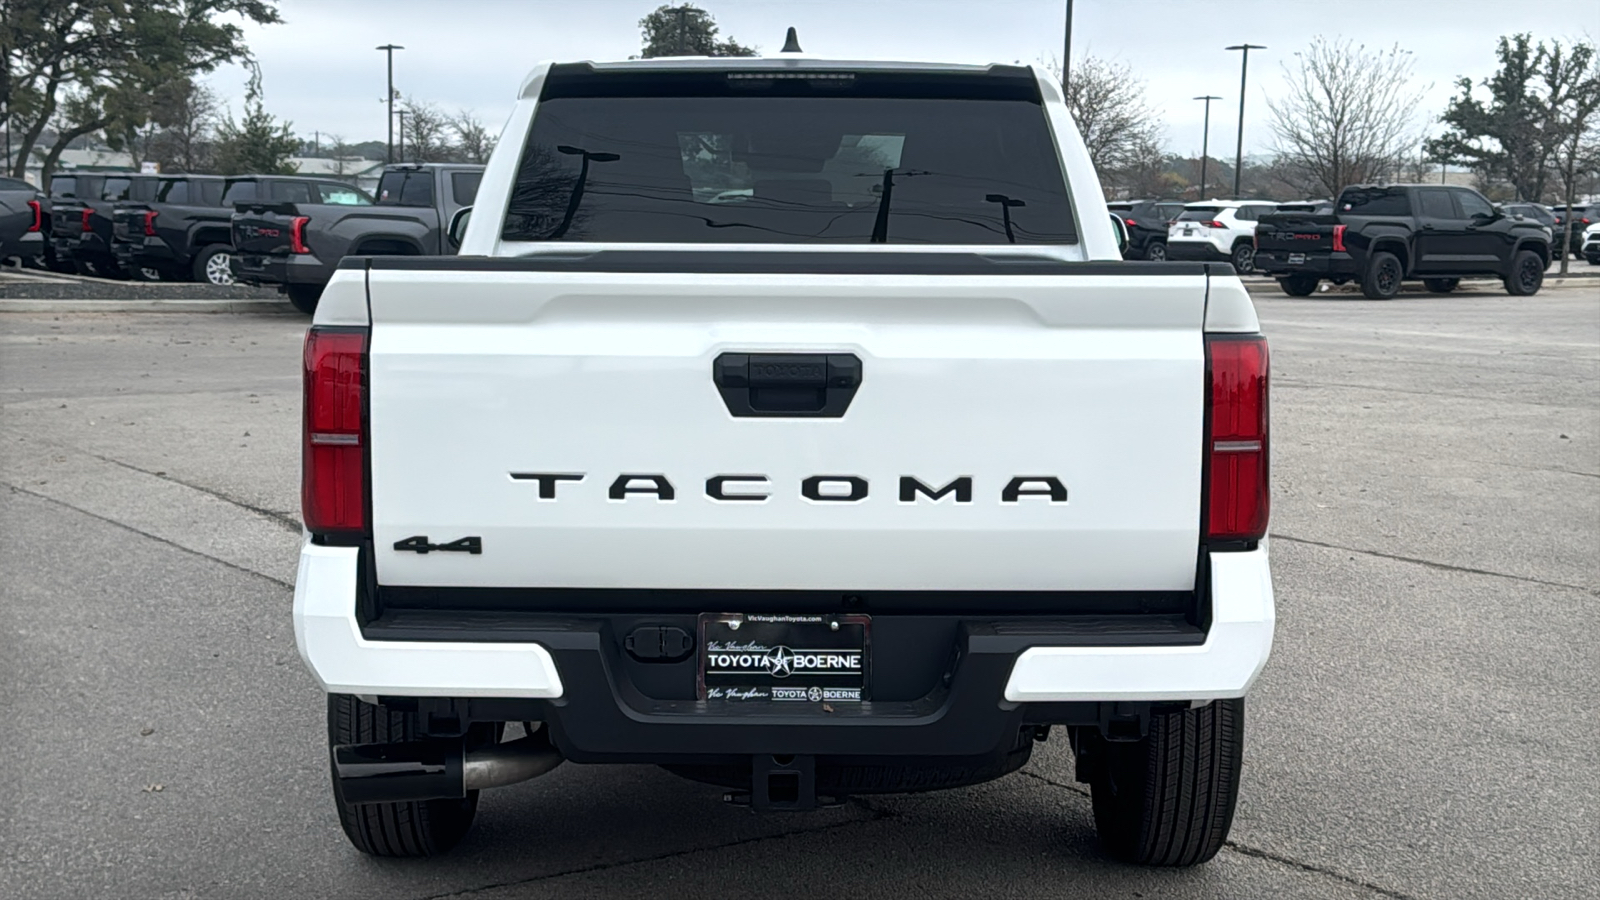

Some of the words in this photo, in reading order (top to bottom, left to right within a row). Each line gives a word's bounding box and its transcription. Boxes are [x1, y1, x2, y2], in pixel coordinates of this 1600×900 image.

[753, 364, 821, 378] TOYOTA
[508, 472, 1068, 502] TACOMA
[747, 614, 822, 623] VicVaughanToyota.com
[708, 654, 770, 668] TOYOTA
[793, 655, 861, 668] BOERNE
[771, 690, 807, 698] TOYOTA
[823, 691, 861, 699] BOERNE
